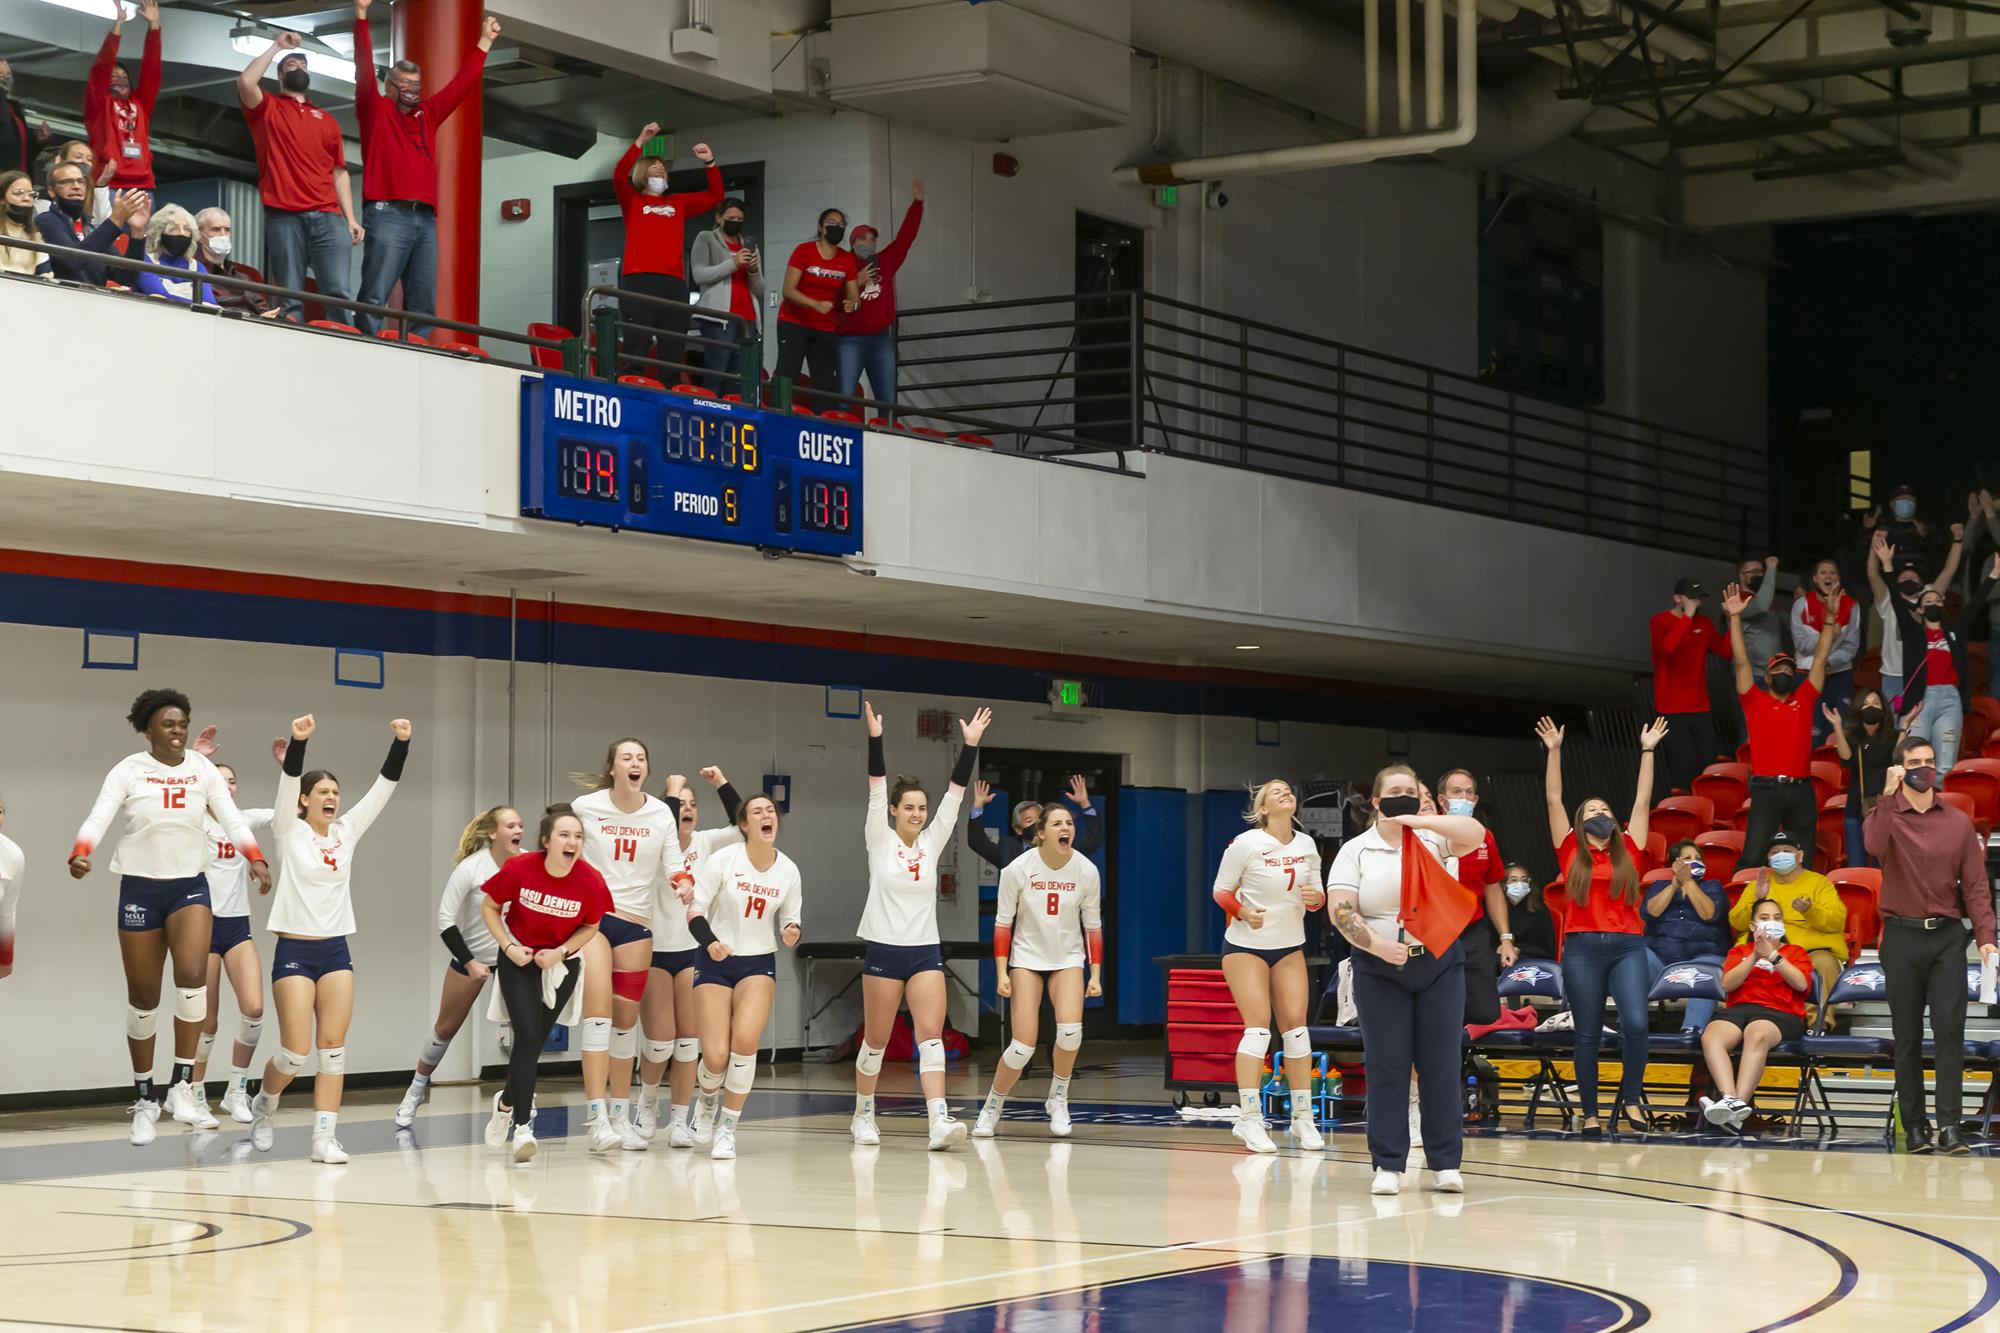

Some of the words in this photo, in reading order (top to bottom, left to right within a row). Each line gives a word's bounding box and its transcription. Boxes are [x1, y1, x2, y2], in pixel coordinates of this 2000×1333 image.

[554, 388, 621, 428] METRO
[693, 399, 732, 411] DAKTRONICS
[700, 419, 758, 471] 1:15
[799, 430, 853, 466] GUEST
[674, 491, 718, 516] PERIOD
[725, 488, 736, 522] 5
[162, 787, 186, 809] 12
[601, 825, 618, 835] MSU
[619, 826, 650, 837] DENVER
[614, 838, 637, 862] 14
[1264, 858, 1280, 867] MSU
[737, 881, 751, 892] MSU
[752, 884, 780, 897] DENVER
[1031, 881, 1046, 890] MSU
[1047, 881, 1076, 892] DENVER
[1283, 868, 1296, 891] 7
[520, 887, 542, 904] MSU
[543, 894, 582, 912] DENVER
[744, 895, 766, 919] 19
[1047, 893, 1059, 915] 8
[125, 912, 145, 920] MSU
